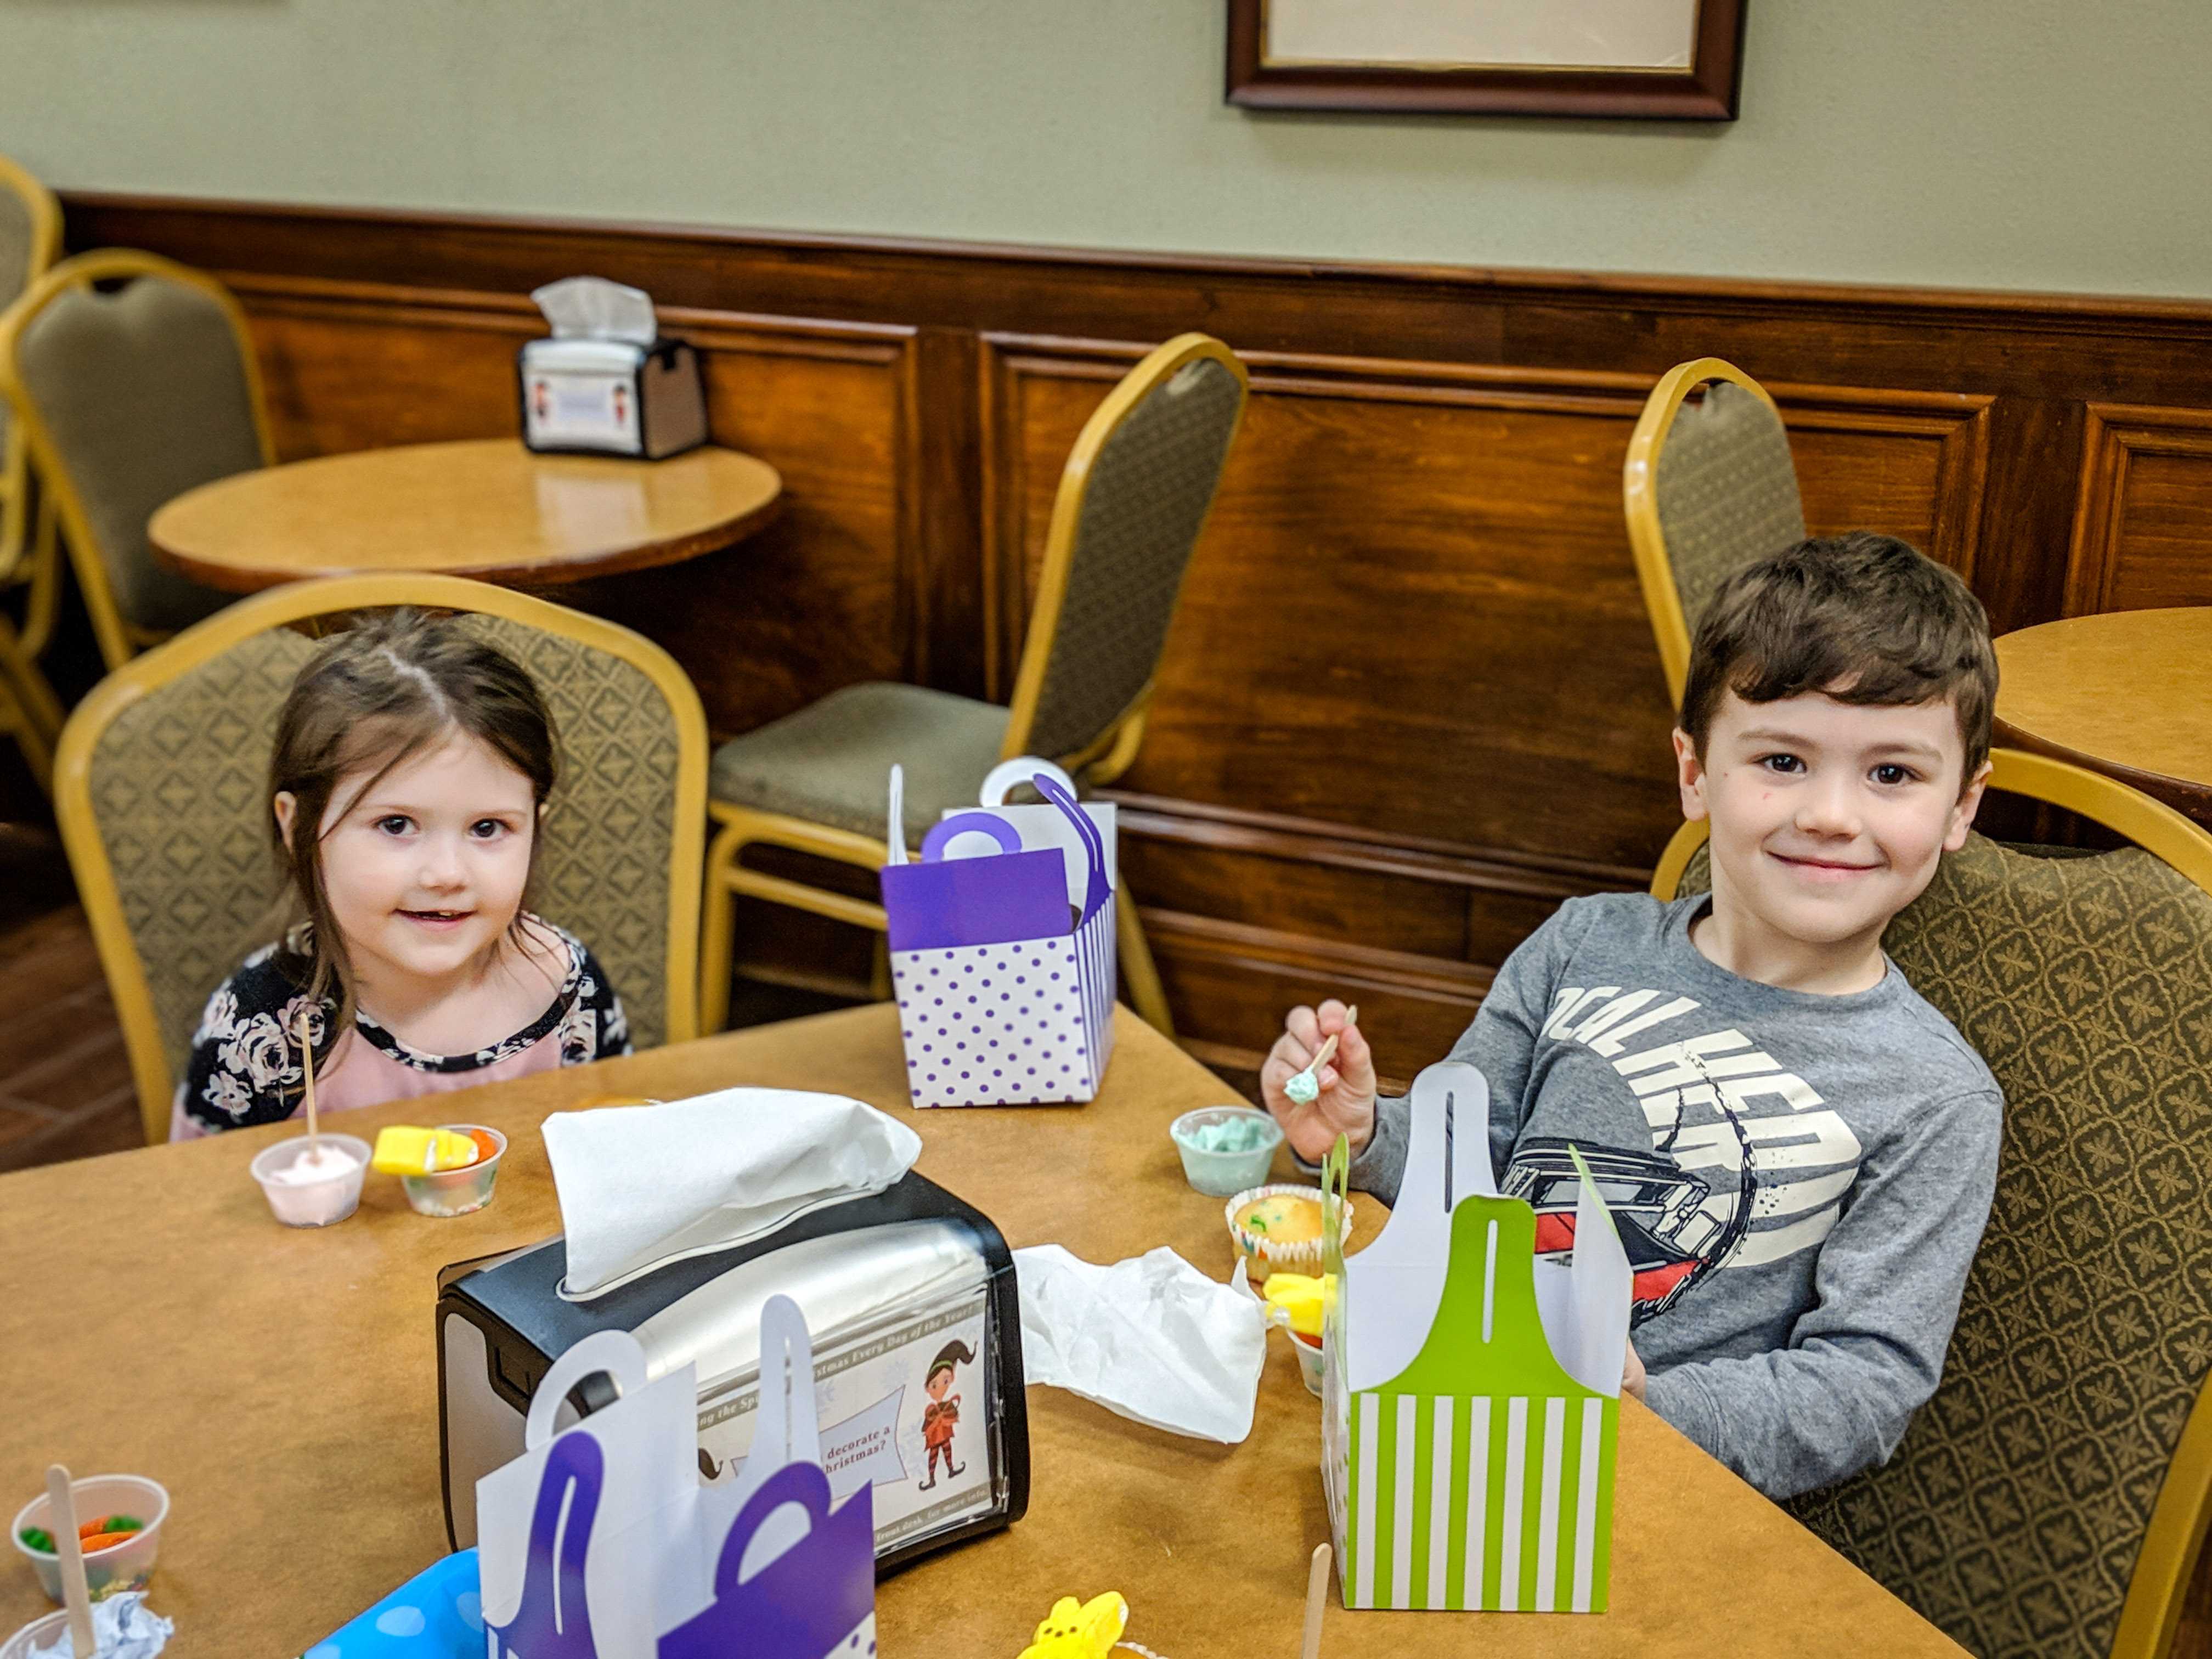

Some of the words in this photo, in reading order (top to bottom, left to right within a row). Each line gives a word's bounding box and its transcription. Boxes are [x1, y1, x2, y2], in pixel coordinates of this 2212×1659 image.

[1541, 986, 1701, 1058] OCAL
[1611, 1028, 1862, 1269] HERO
[718, 1404, 736, 1418] the
[816, 1357, 849, 1378] stmas
[852, 1343, 884, 1363] Every
[887, 1333, 908, 1346] Day
[911, 1324, 922, 1339] of
[924, 1317, 941, 1331] the
[825, 1440, 887, 1474] hristmas?
[827, 1431, 879, 1459] decorate
[884, 1426, 890, 1435] a
